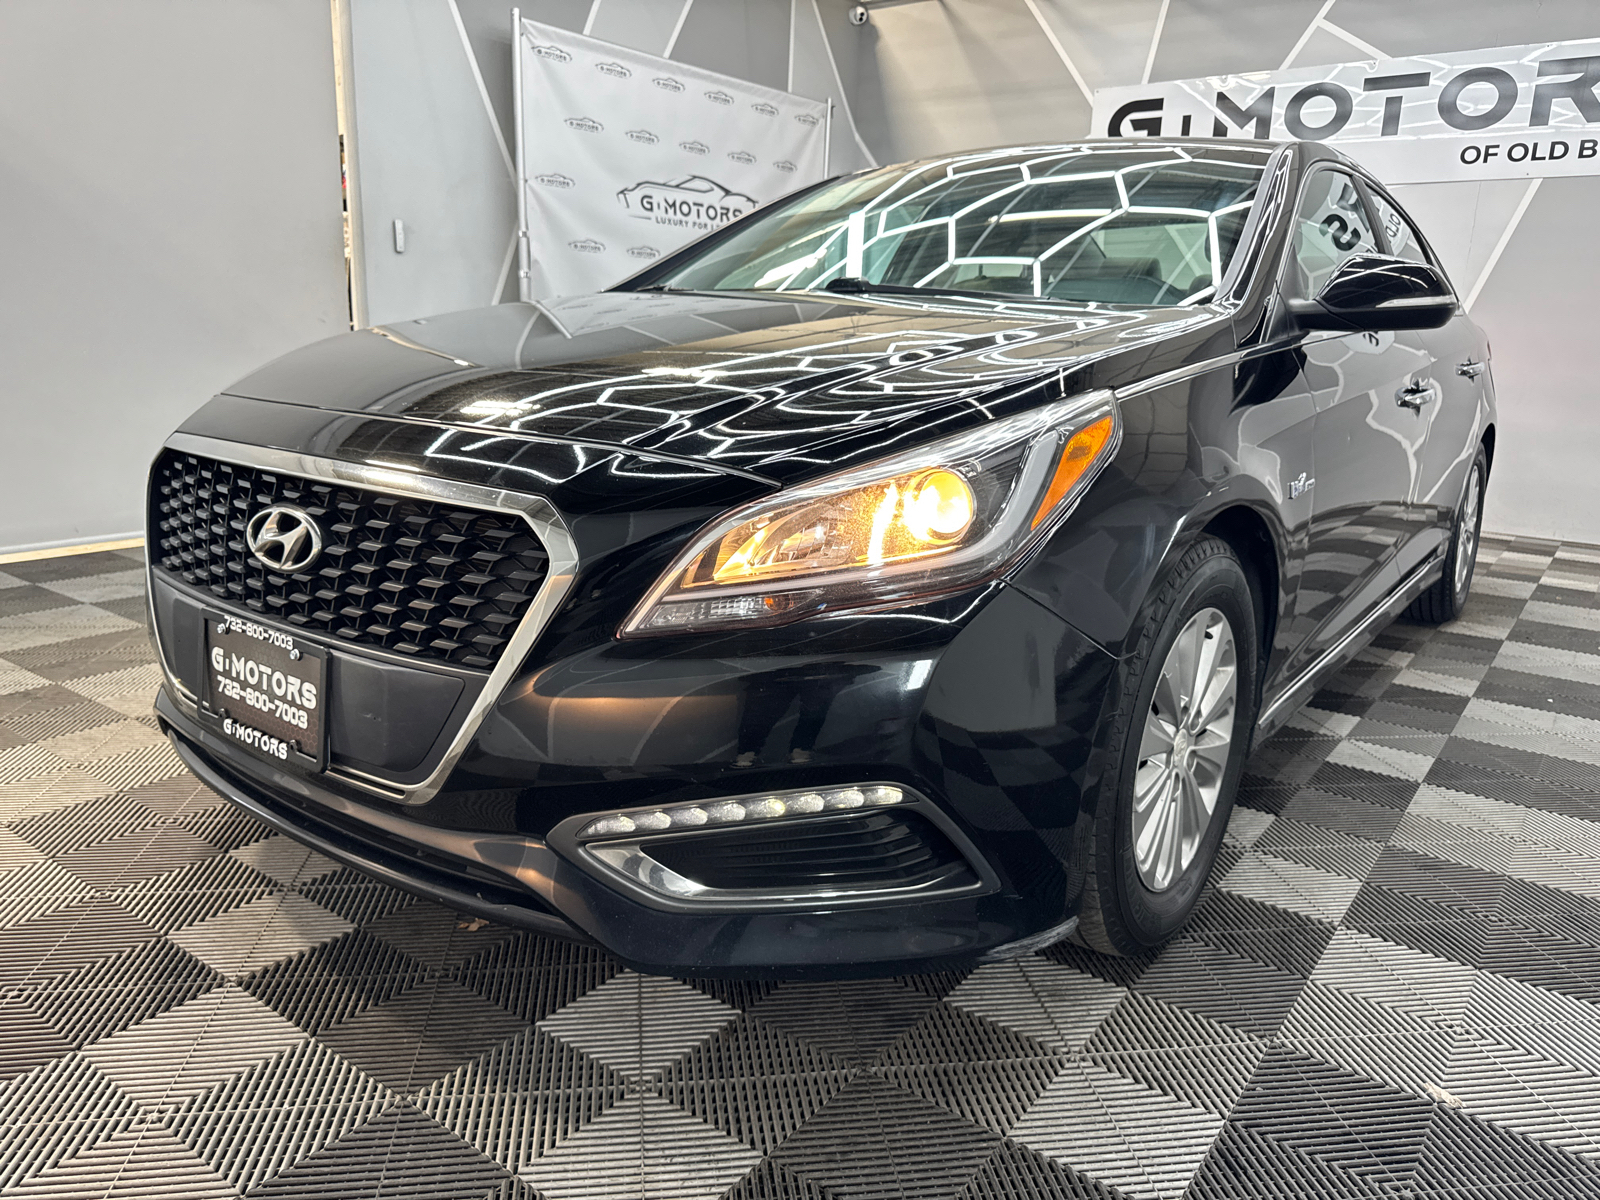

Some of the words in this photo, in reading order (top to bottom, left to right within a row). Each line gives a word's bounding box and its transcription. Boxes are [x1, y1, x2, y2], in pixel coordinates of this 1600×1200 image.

[1459, 144, 1500, 165] OF
[1506, 140, 1570, 163] OLD
[655, 215, 689, 228] LUXURY
[692, 221, 708, 230] FOR
[224, 615, 293, 650] 732-800-7003
[217, 675, 308, 729] 732-800-7003
